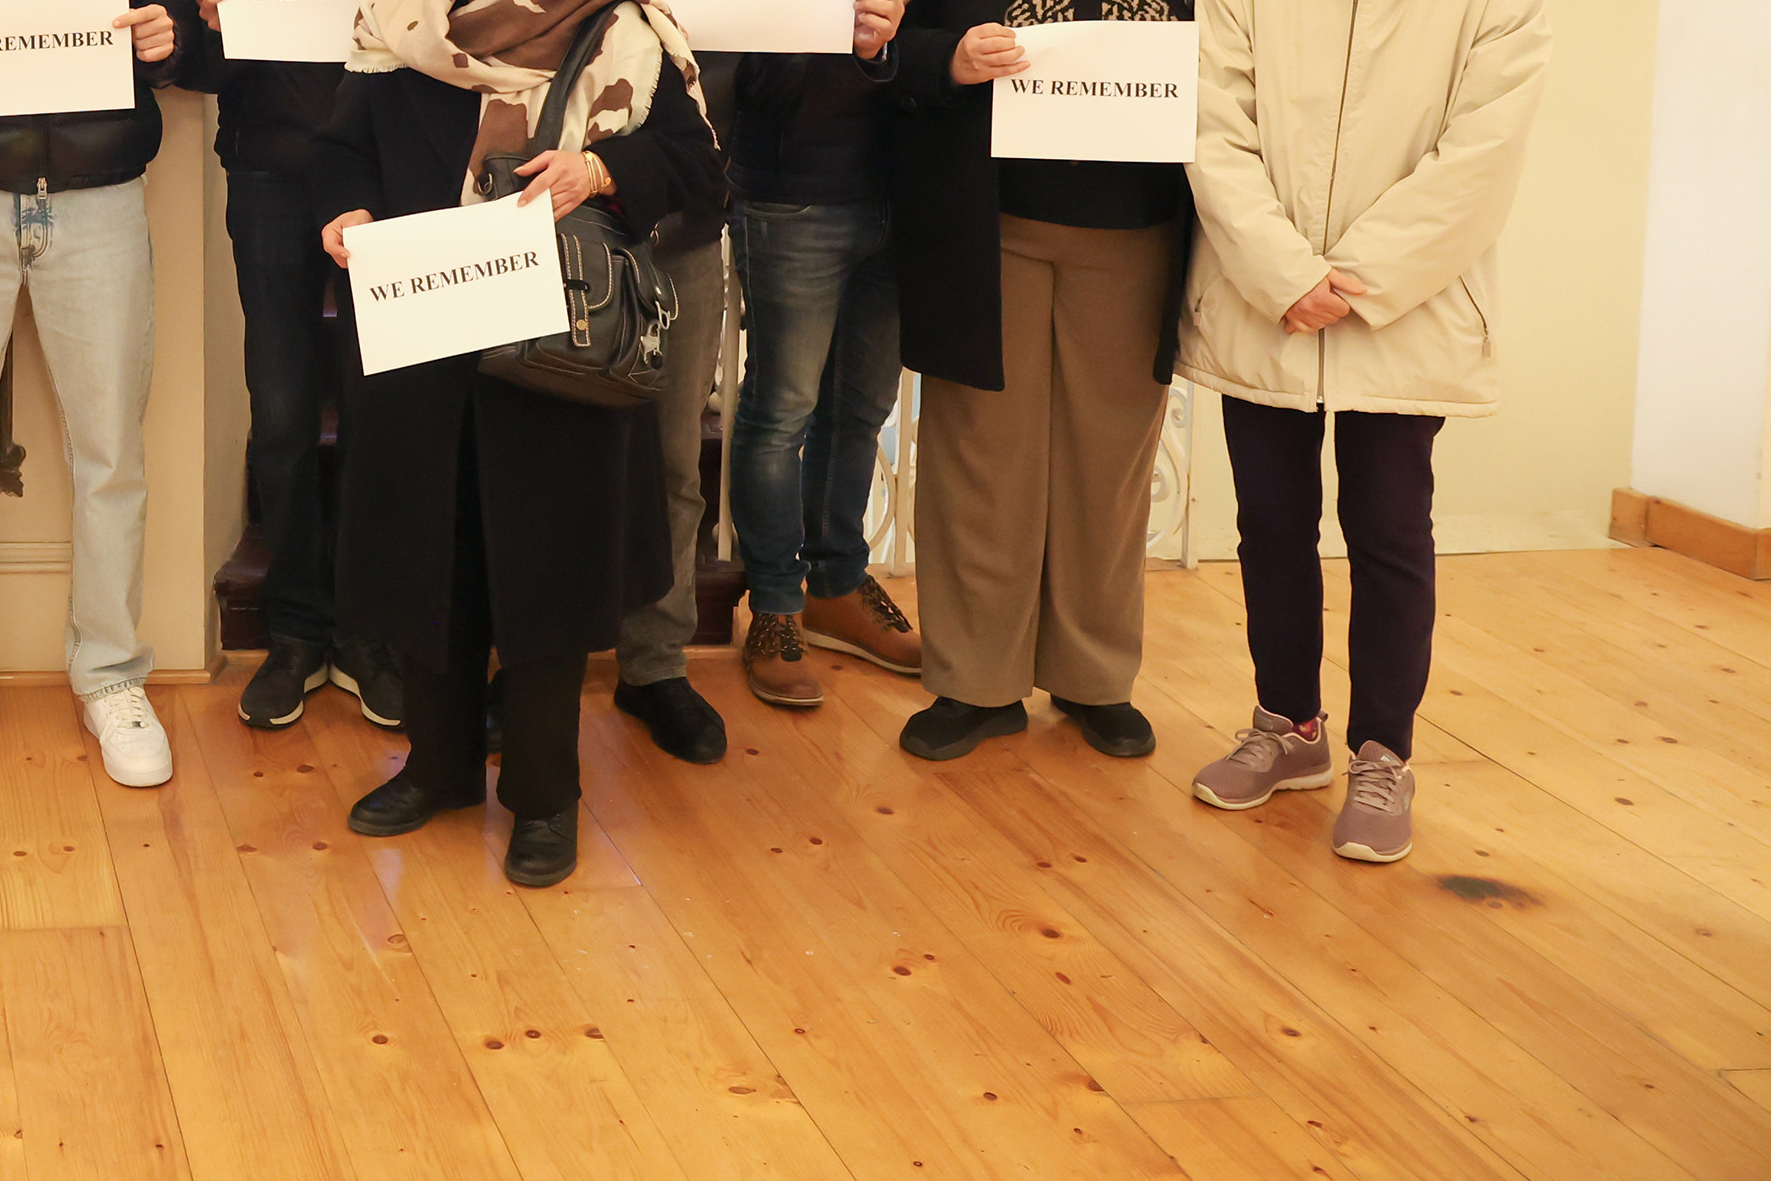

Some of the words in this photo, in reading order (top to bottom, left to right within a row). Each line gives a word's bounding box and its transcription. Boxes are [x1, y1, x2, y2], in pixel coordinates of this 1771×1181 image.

[1011, 79, 1044, 94] WE
[1051, 81, 1178, 98] REMEMBER
[370, 281, 404, 302] WE
[410, 252, 539, 294] REMEMBER
